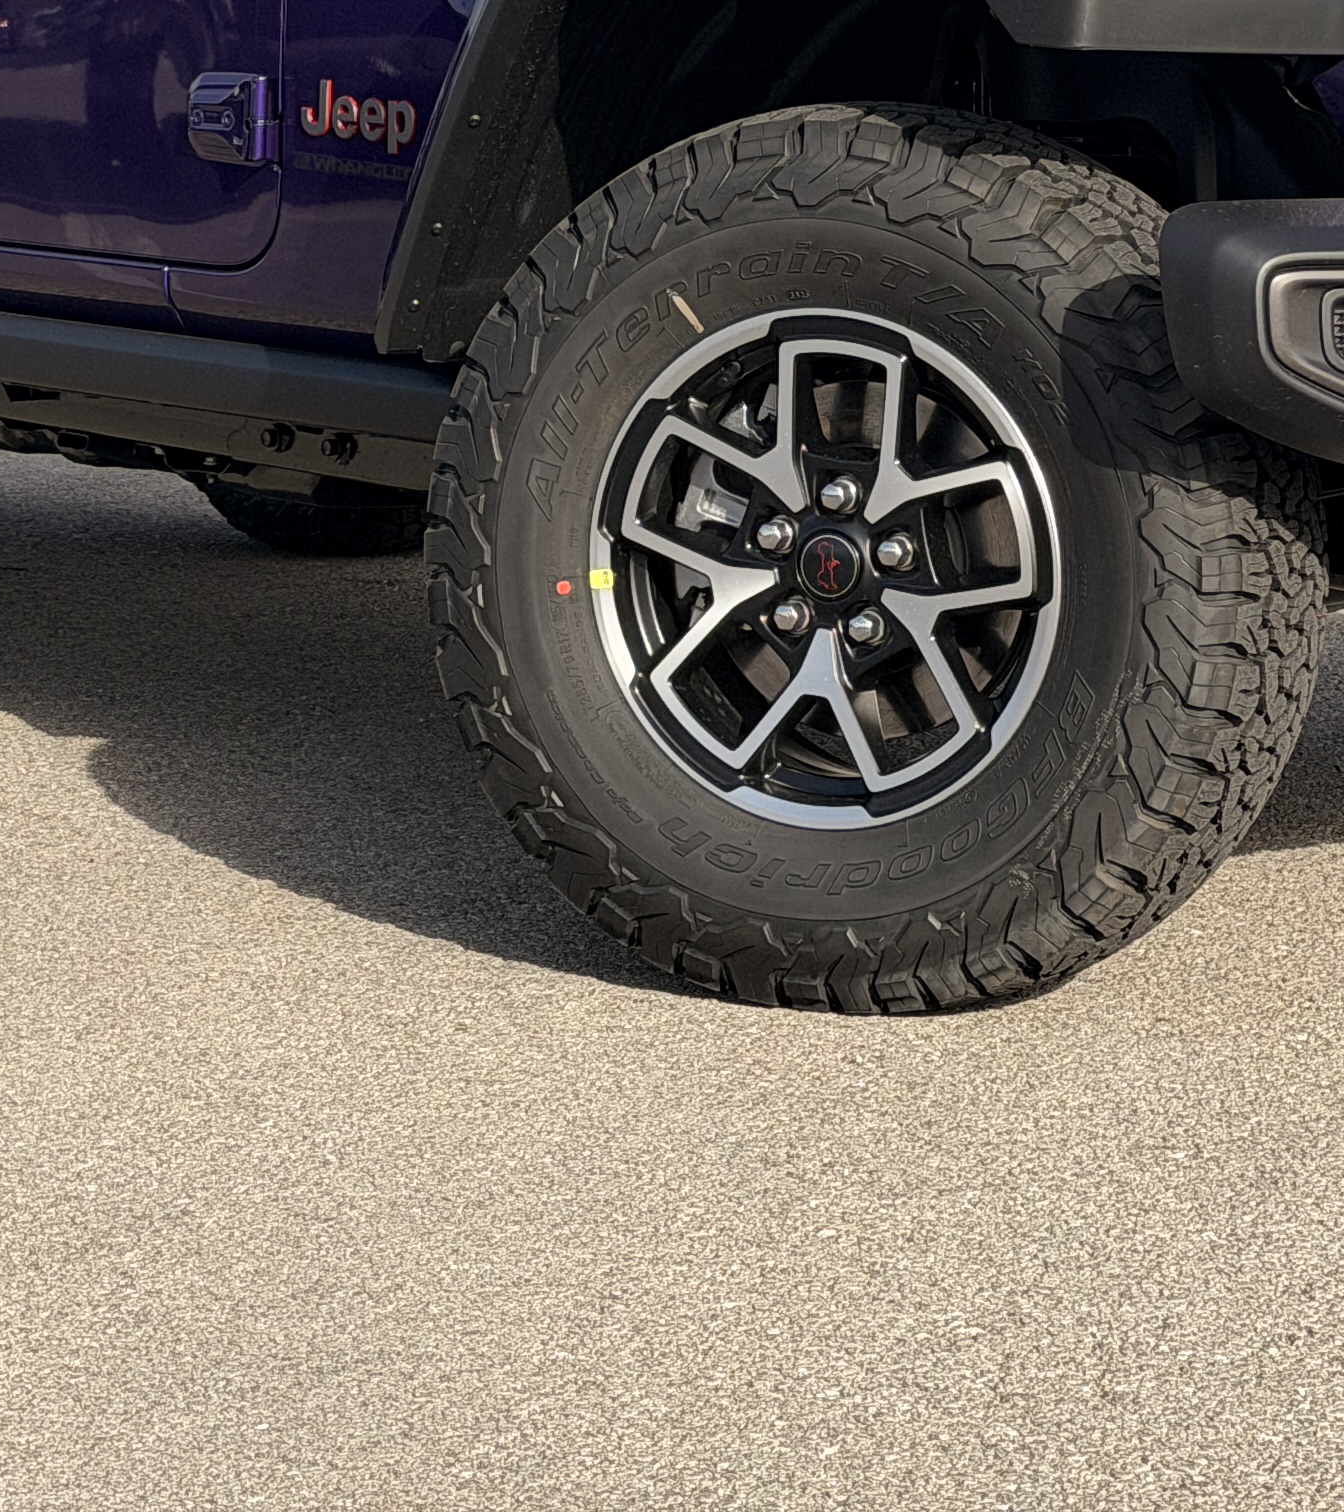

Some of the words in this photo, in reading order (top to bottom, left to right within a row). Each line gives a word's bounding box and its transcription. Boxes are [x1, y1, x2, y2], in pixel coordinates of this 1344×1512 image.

[300, 78, 418, 155] Jeep
[525, 240, 863, 523] All-Terrain
[879, 254, 1007, 349] T/A
[657, 668, 1096, 897] BFGoodrich
